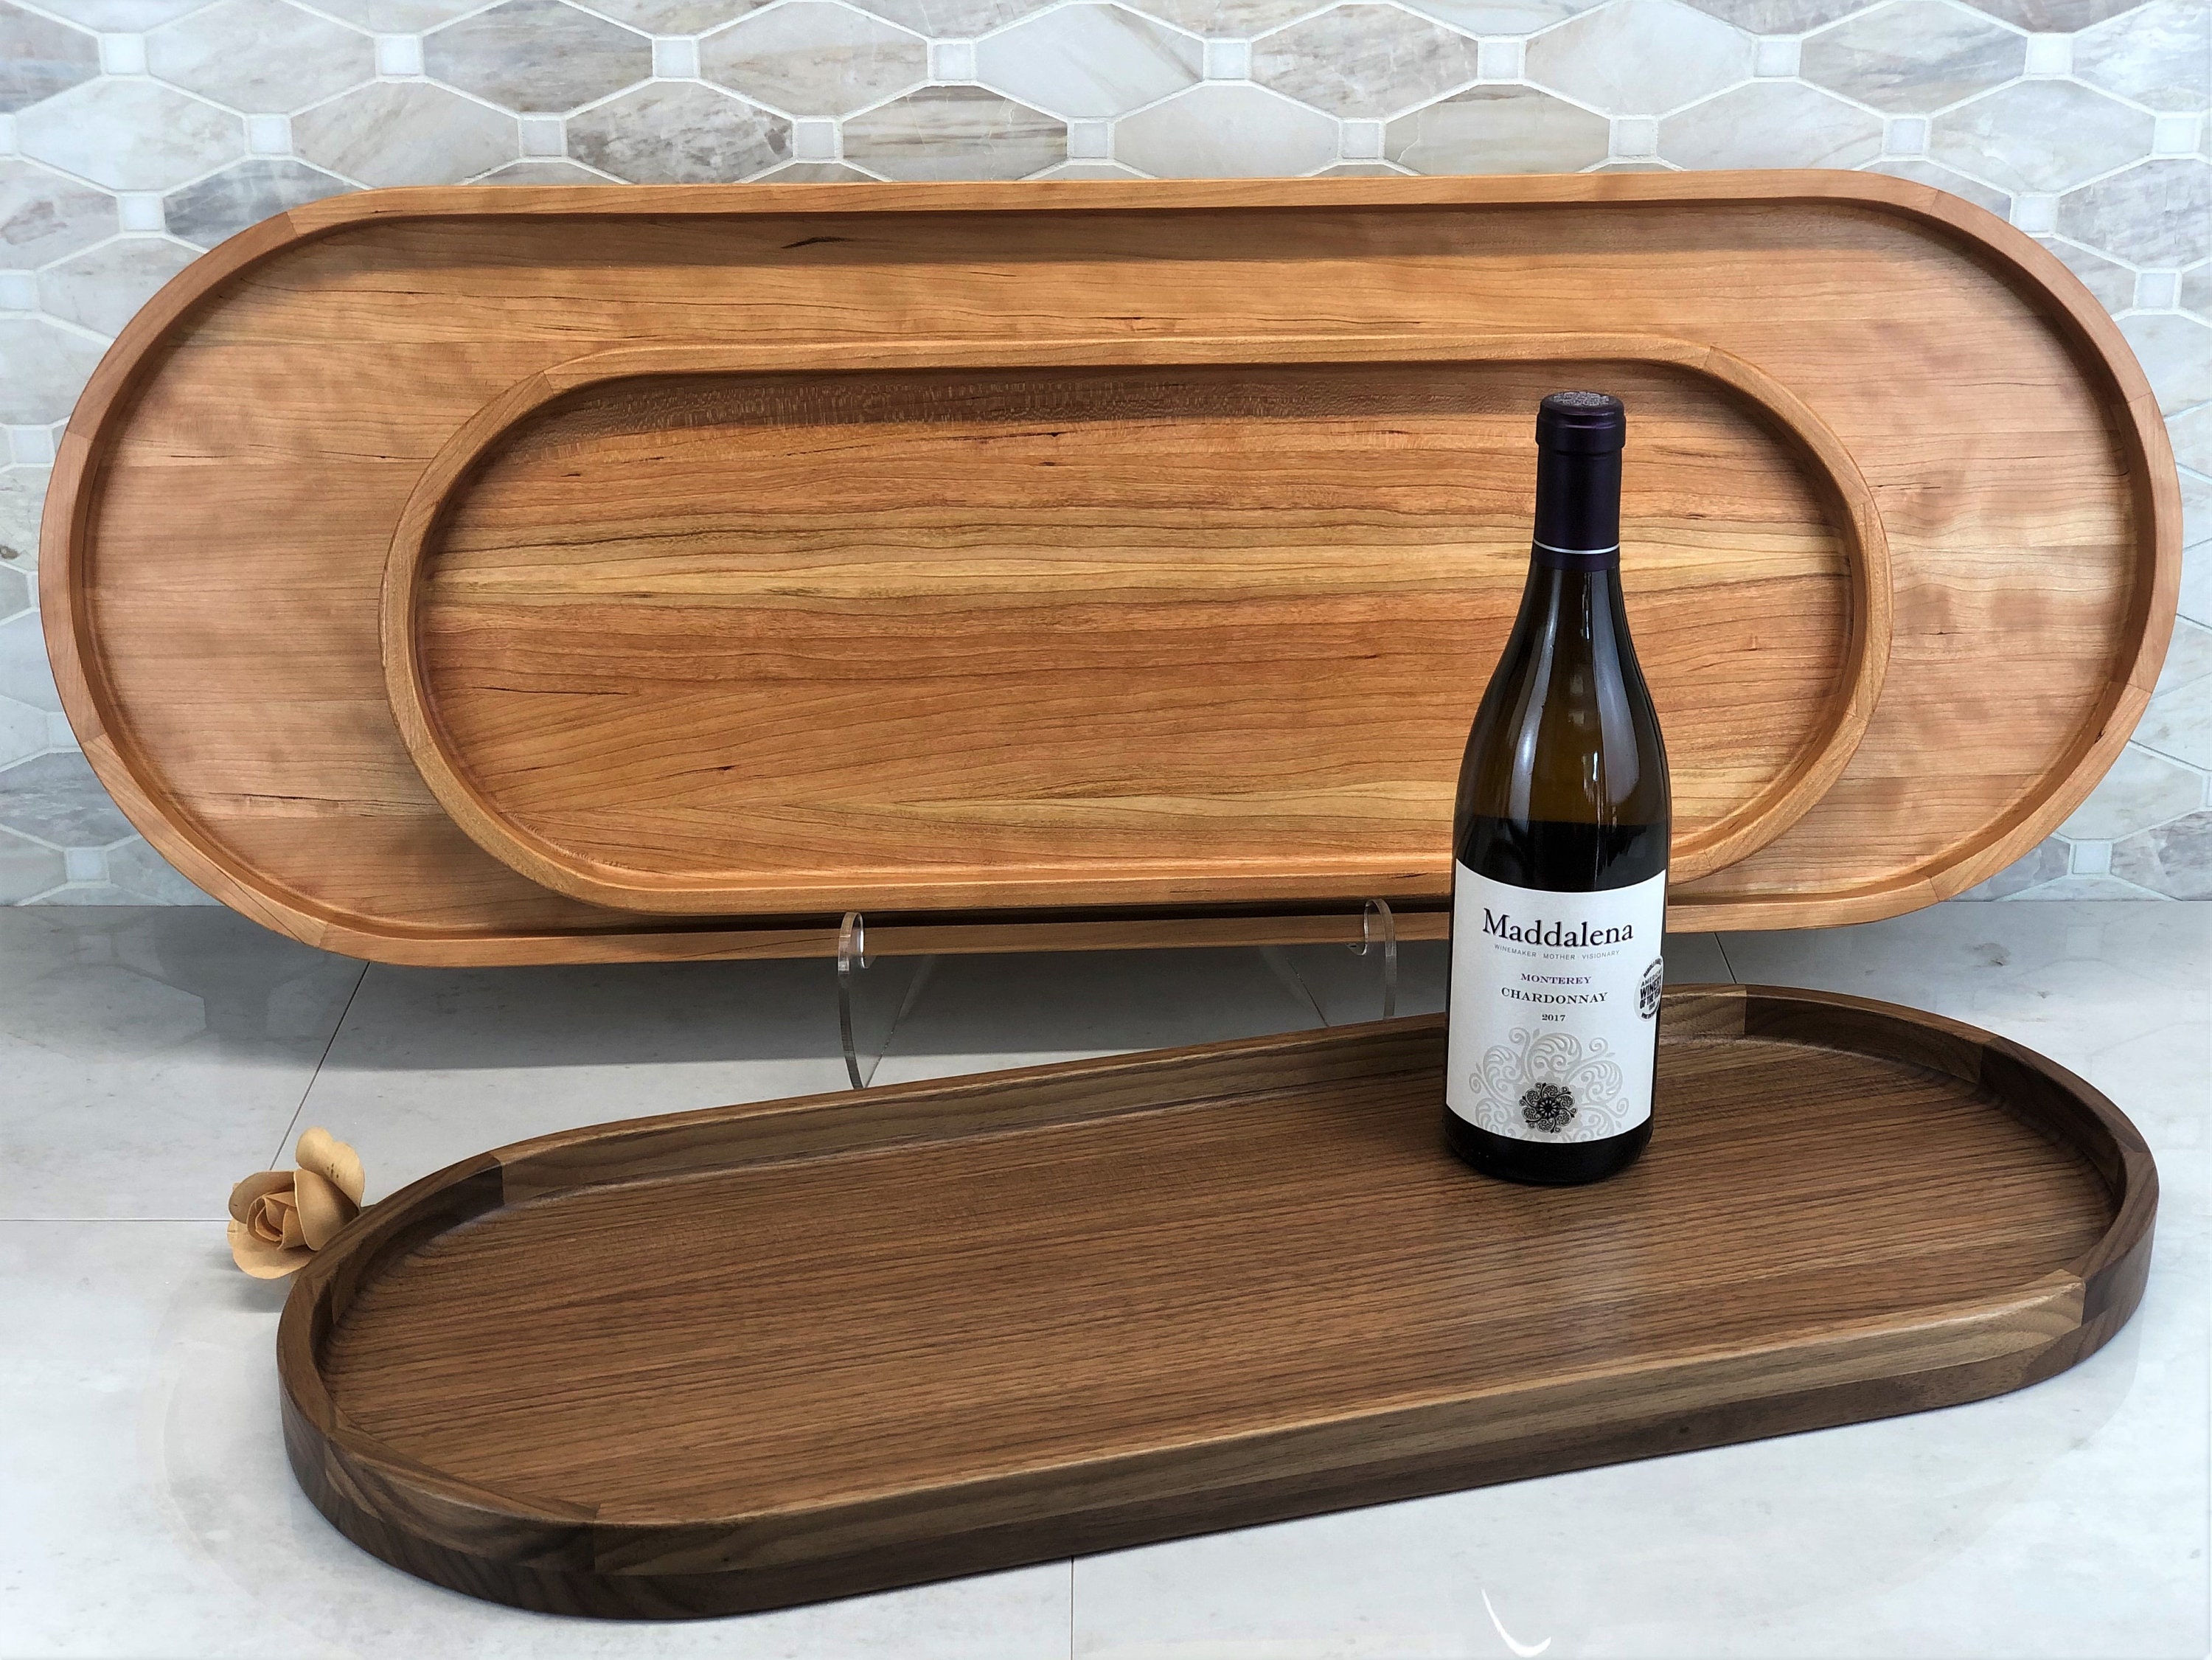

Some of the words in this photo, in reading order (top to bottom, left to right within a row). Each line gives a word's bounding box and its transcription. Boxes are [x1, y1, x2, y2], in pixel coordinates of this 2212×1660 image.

[1483, 909, 1633, 947] Maddalena
[1495, 944, 1537, 957] WINEMAKER
[1582, 950, 1620, 959] VISIONARY
[1521, 973, 1591, 984] MONTEREY
[1501, 987, 1608, 1004] CHARDONNAY
[1640, 998, 1646, 1009] OF
[1542, 1013, 1566, 1021] 2017
